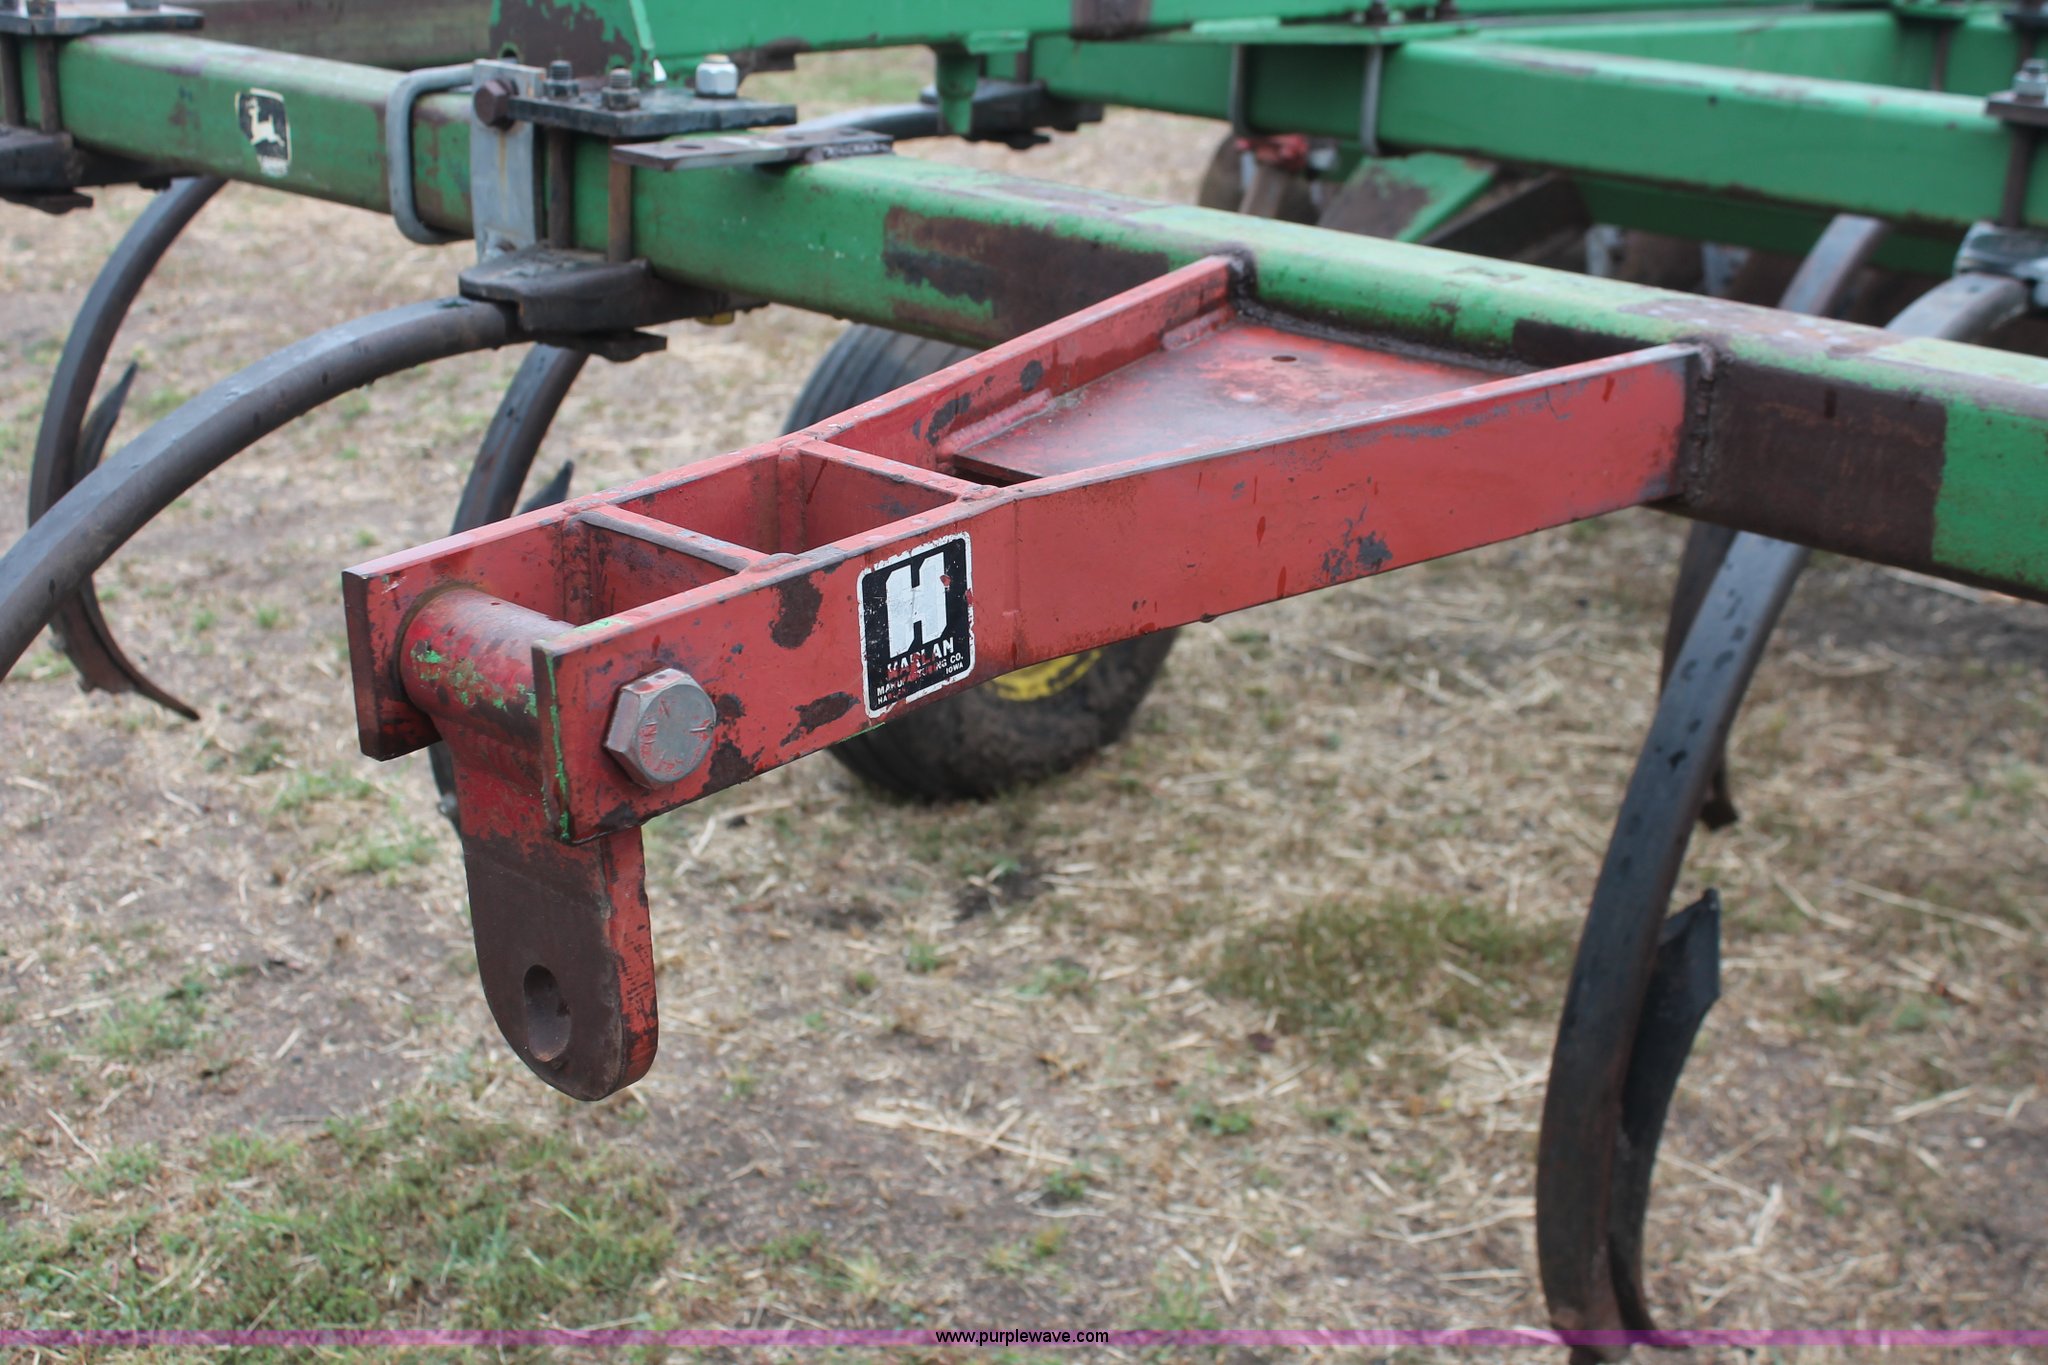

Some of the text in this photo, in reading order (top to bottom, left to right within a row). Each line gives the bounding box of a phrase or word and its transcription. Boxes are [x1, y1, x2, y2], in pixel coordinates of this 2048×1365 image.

[886, 552, 947, 658] H
[950, 652, 964, 664] CO.
[945, 662, 964, 675] IOWA
